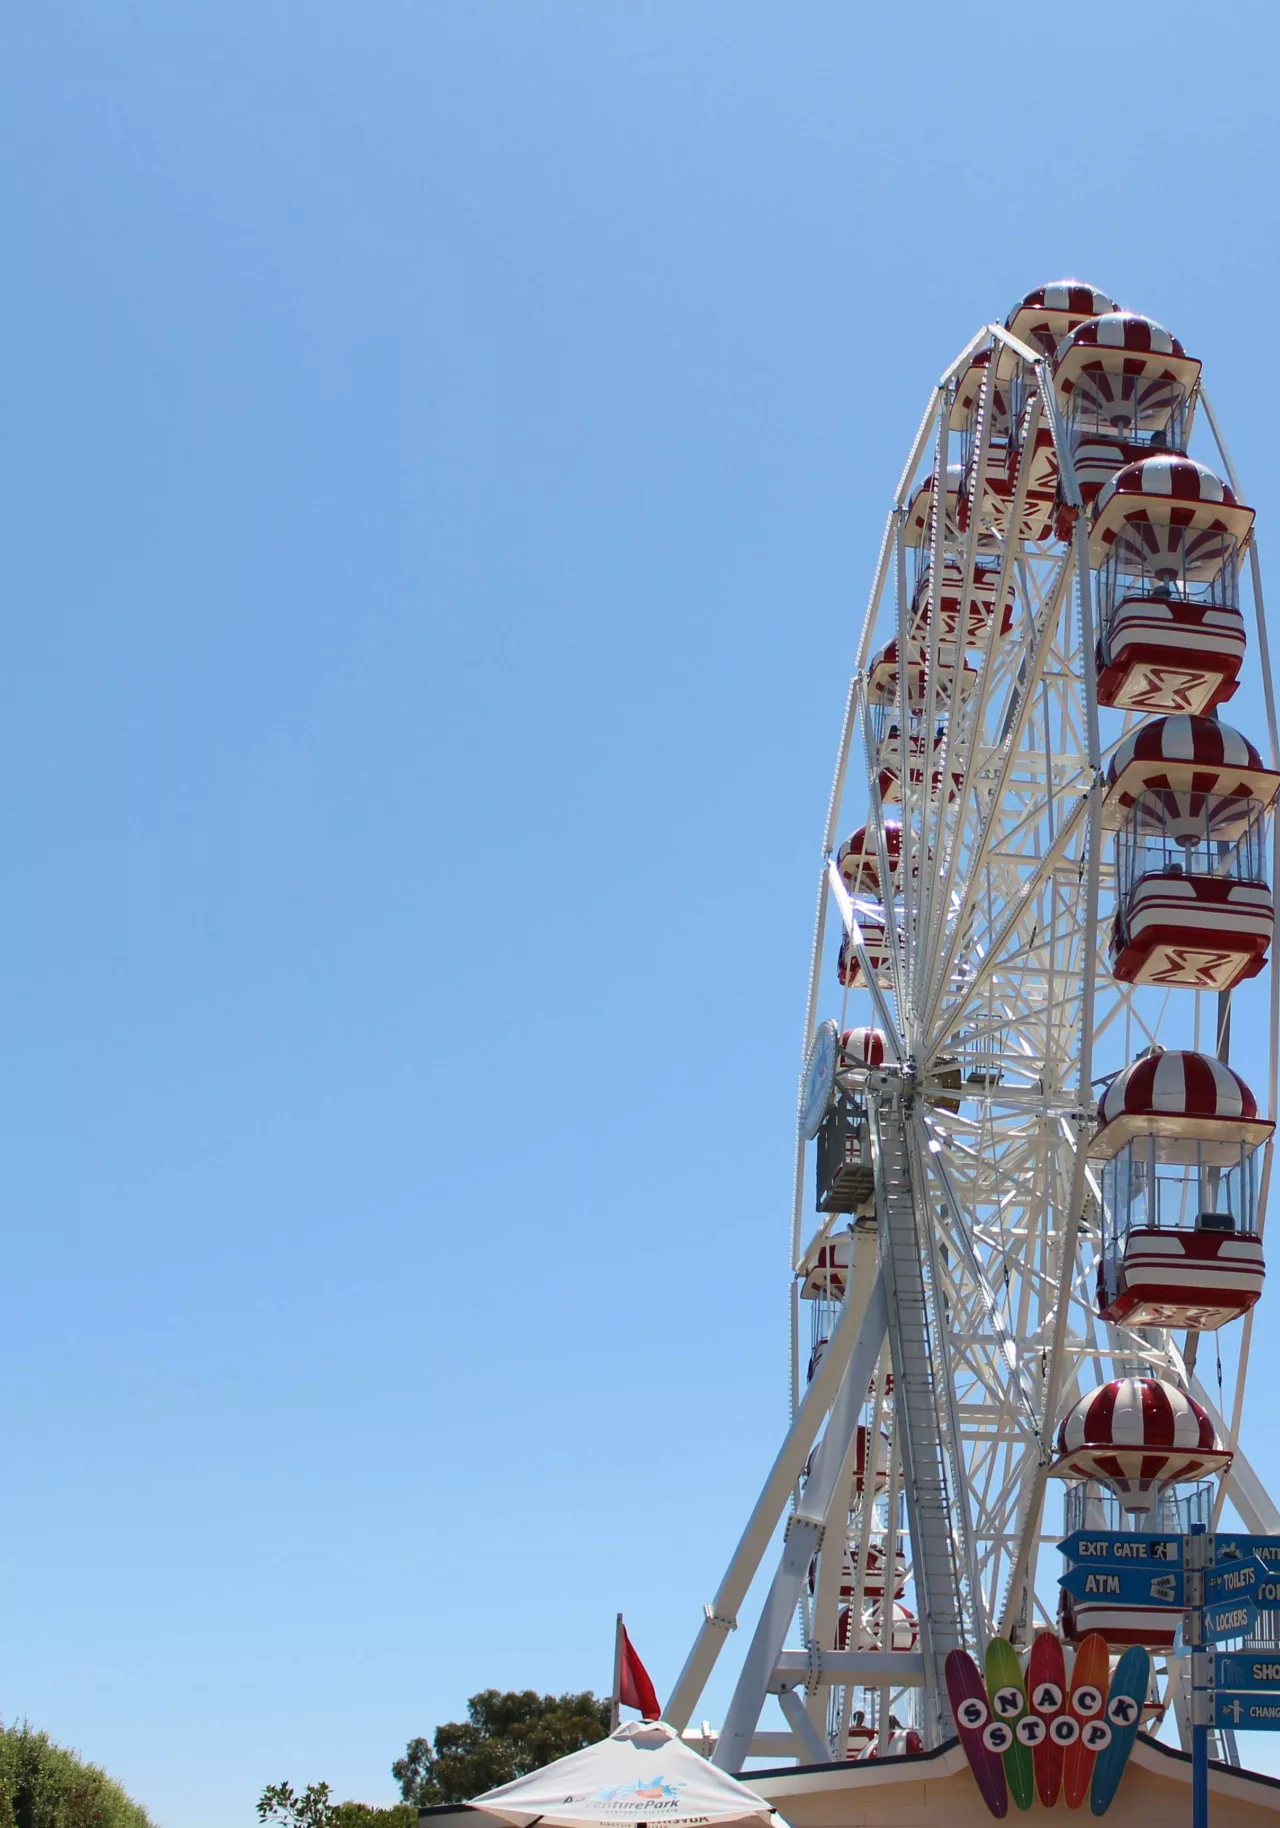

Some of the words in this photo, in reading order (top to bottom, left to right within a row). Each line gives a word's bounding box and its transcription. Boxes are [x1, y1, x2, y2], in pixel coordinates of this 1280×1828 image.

[1078, 1541, 1109, 1556] EXIT
[1113, 1542, 1147, 1558] GATE
[1085, 1574, 1121, 1594] ATM
[1224, 1567, 1256, 1591] TOILETS
[1215, 1608, 1248, 1632] LOCKERS
[963, 1687, 1135, 1723] SNACK
[989, 1720, 1107, 1747] STOP
